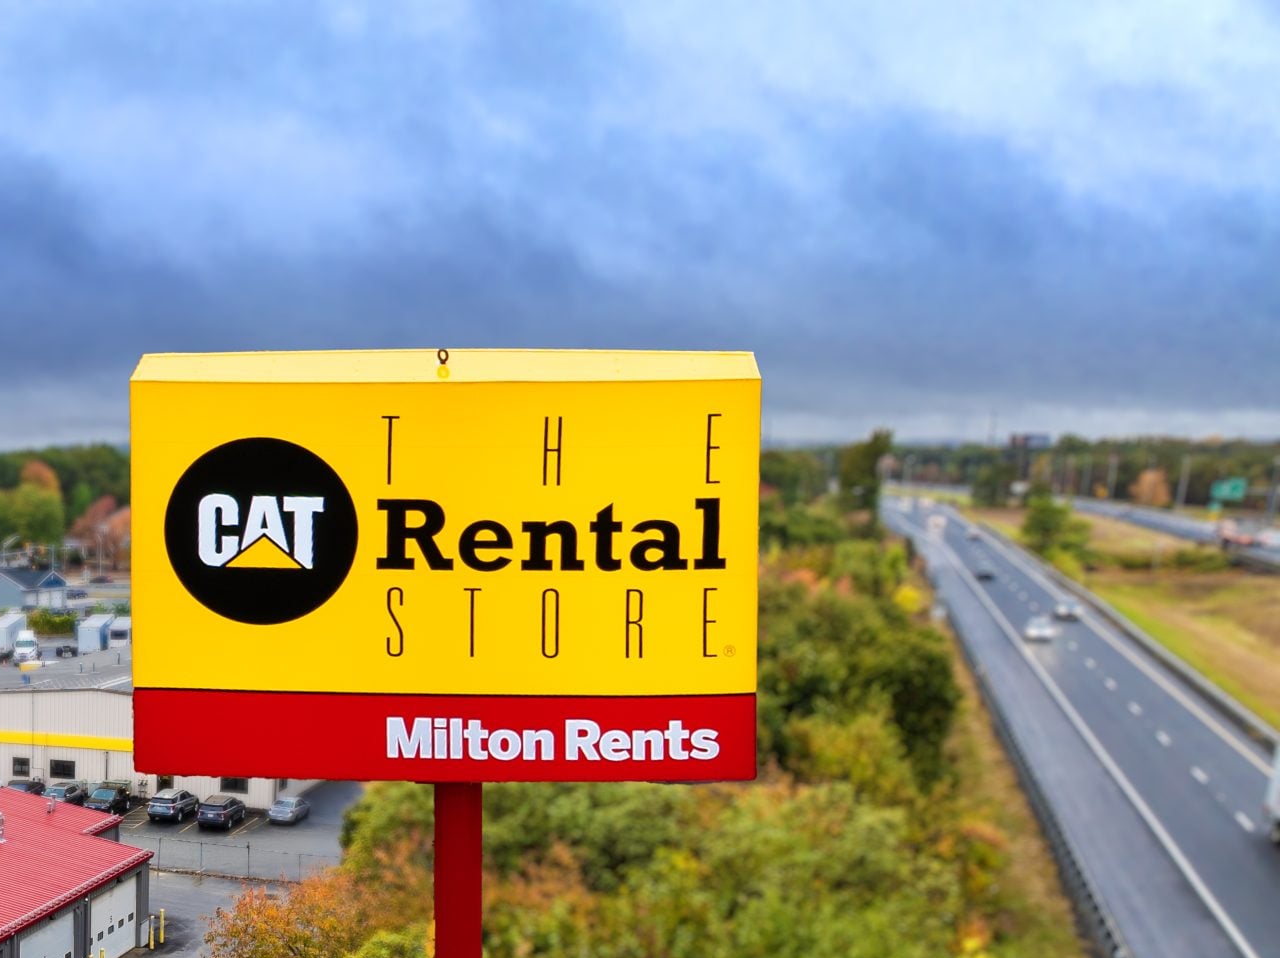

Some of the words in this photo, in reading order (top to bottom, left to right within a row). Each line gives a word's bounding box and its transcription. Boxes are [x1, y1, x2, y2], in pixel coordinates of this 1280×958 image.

[381, 413, 722, 486] THE
[198, 492, 325, 570] CAT
[375, 497, 727, 572] Rental
[385, 586, 719, 659] STORE
[385, 717, 555, 761] Milton
[564, 719, 721, 762] Rents
